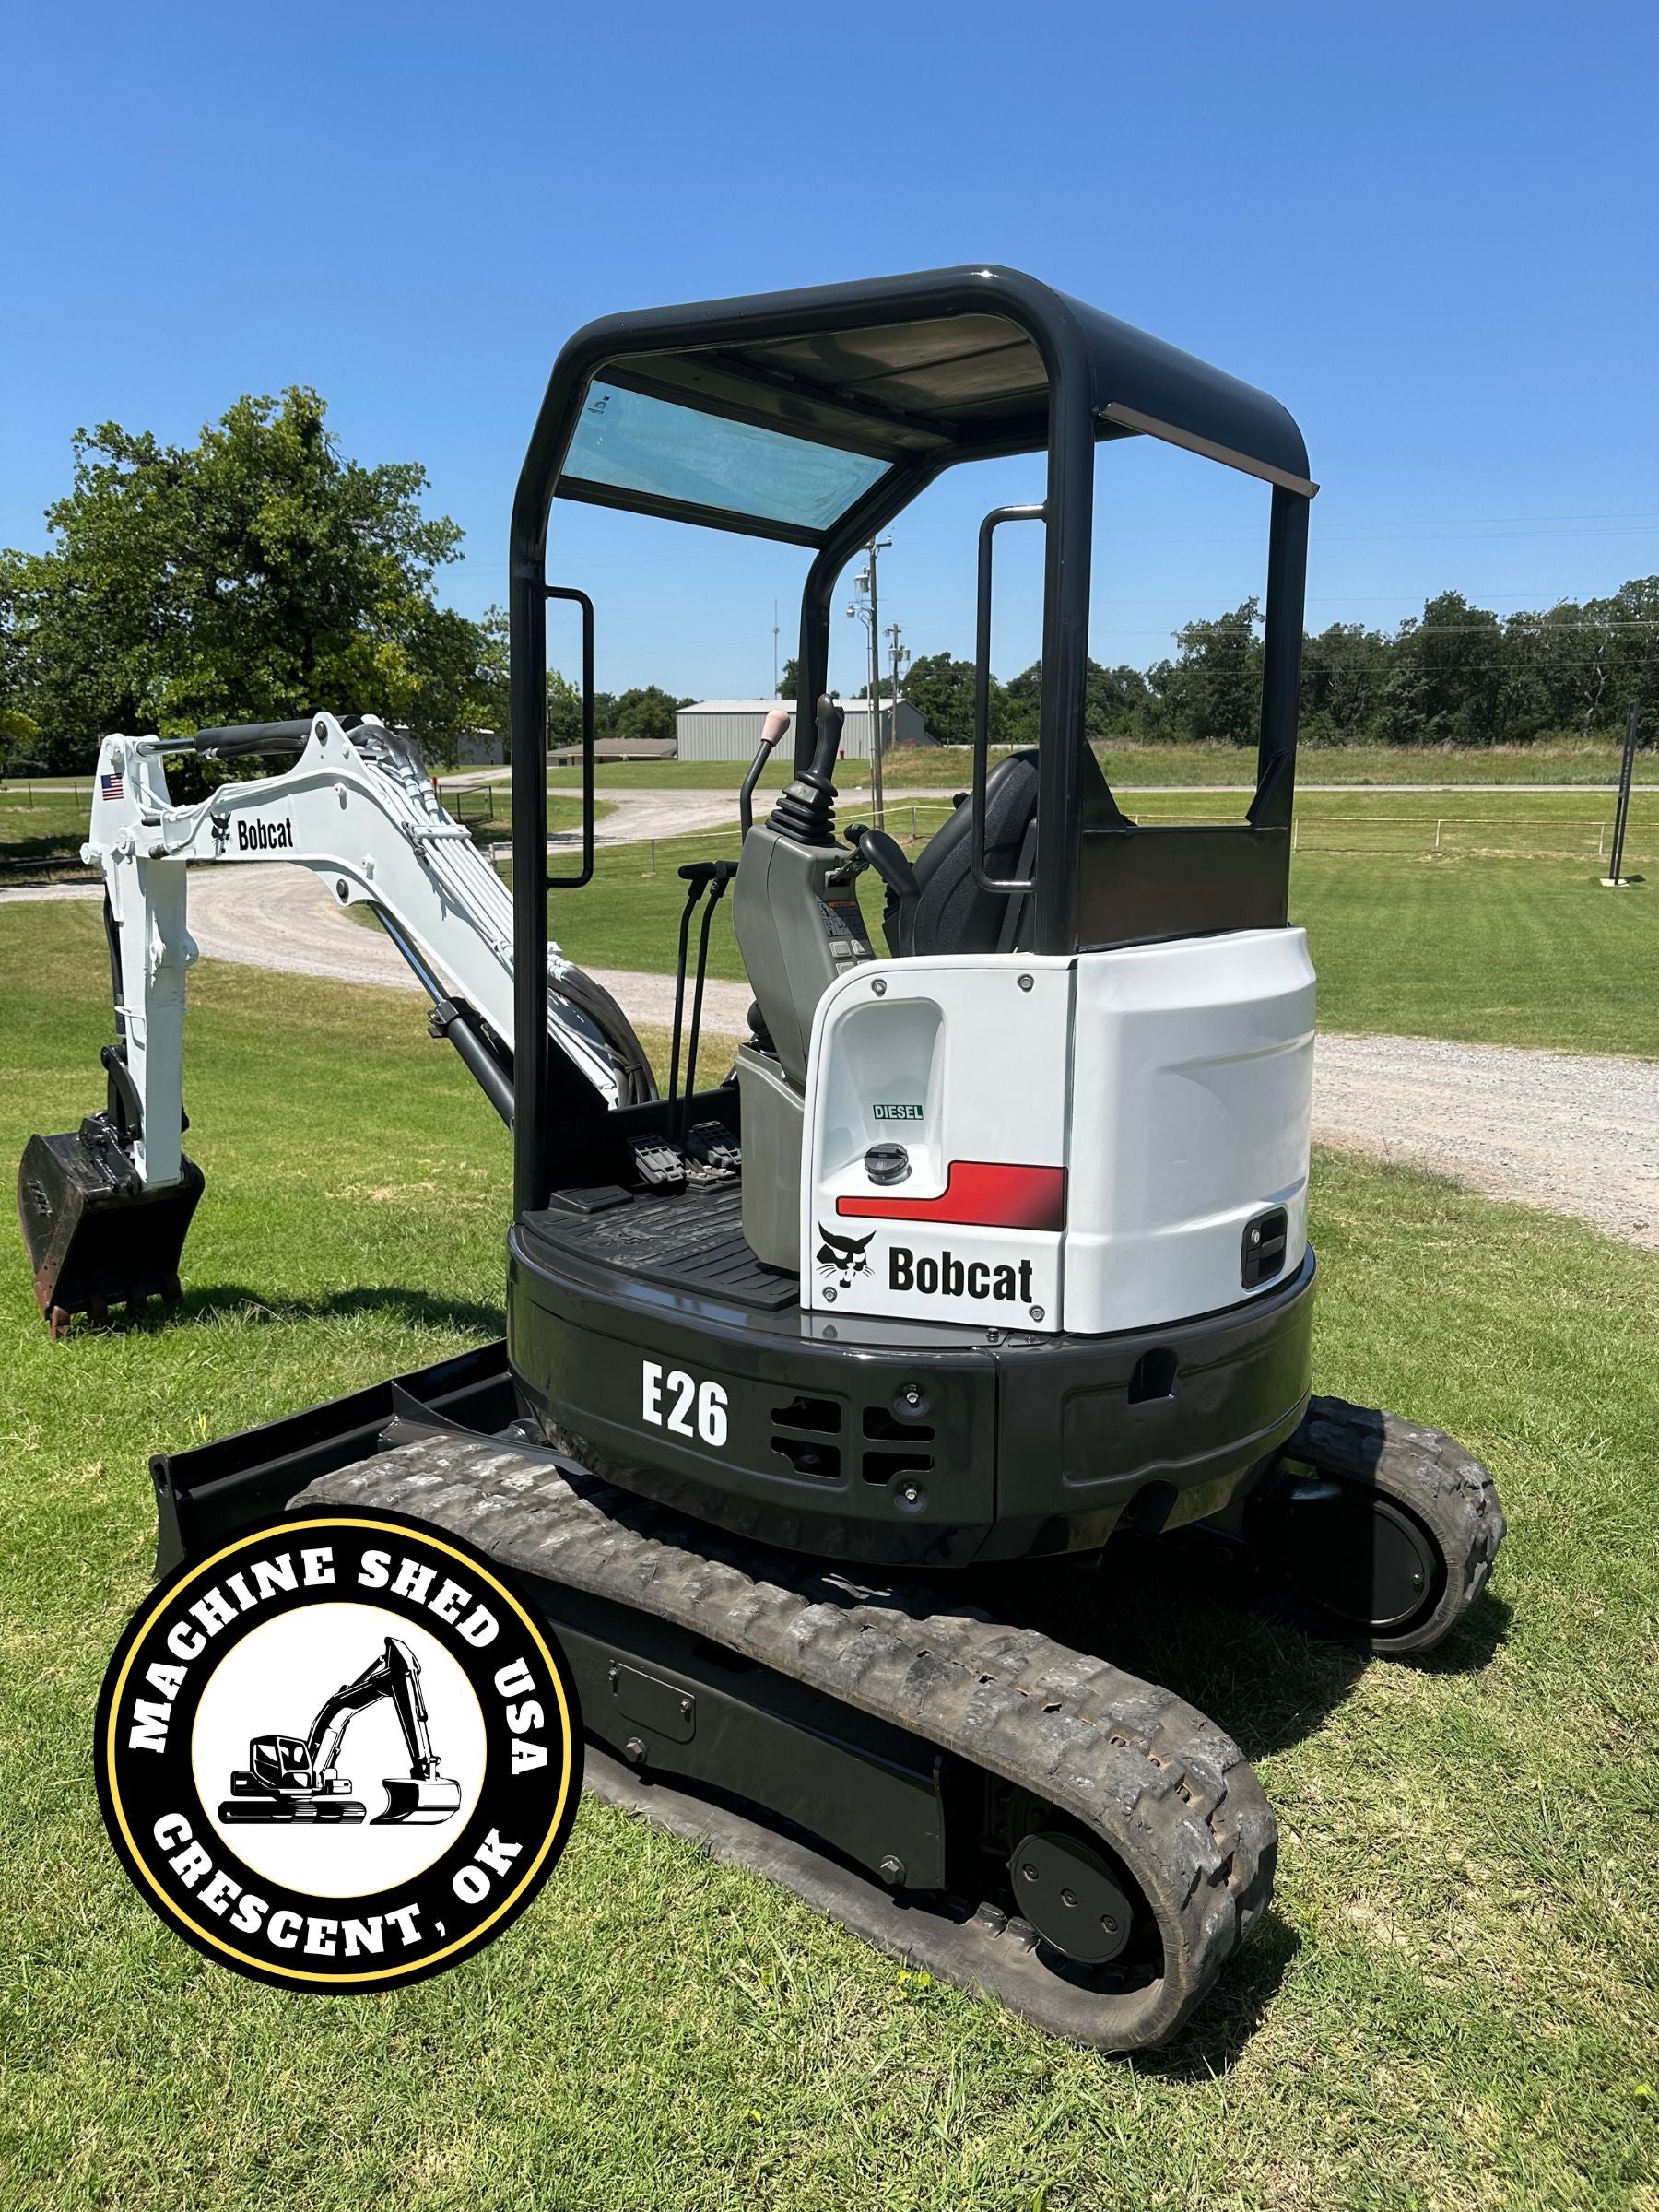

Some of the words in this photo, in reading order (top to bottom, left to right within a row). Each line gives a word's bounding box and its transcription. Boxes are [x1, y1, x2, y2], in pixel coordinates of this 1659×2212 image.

[237, 817, 294, 851] Bobcat
[874, 1105, 923, 1119] DIESEL
[888, 1246, 1033, 1304] Bobcat
[642, 1359, 728, 1447] E26
